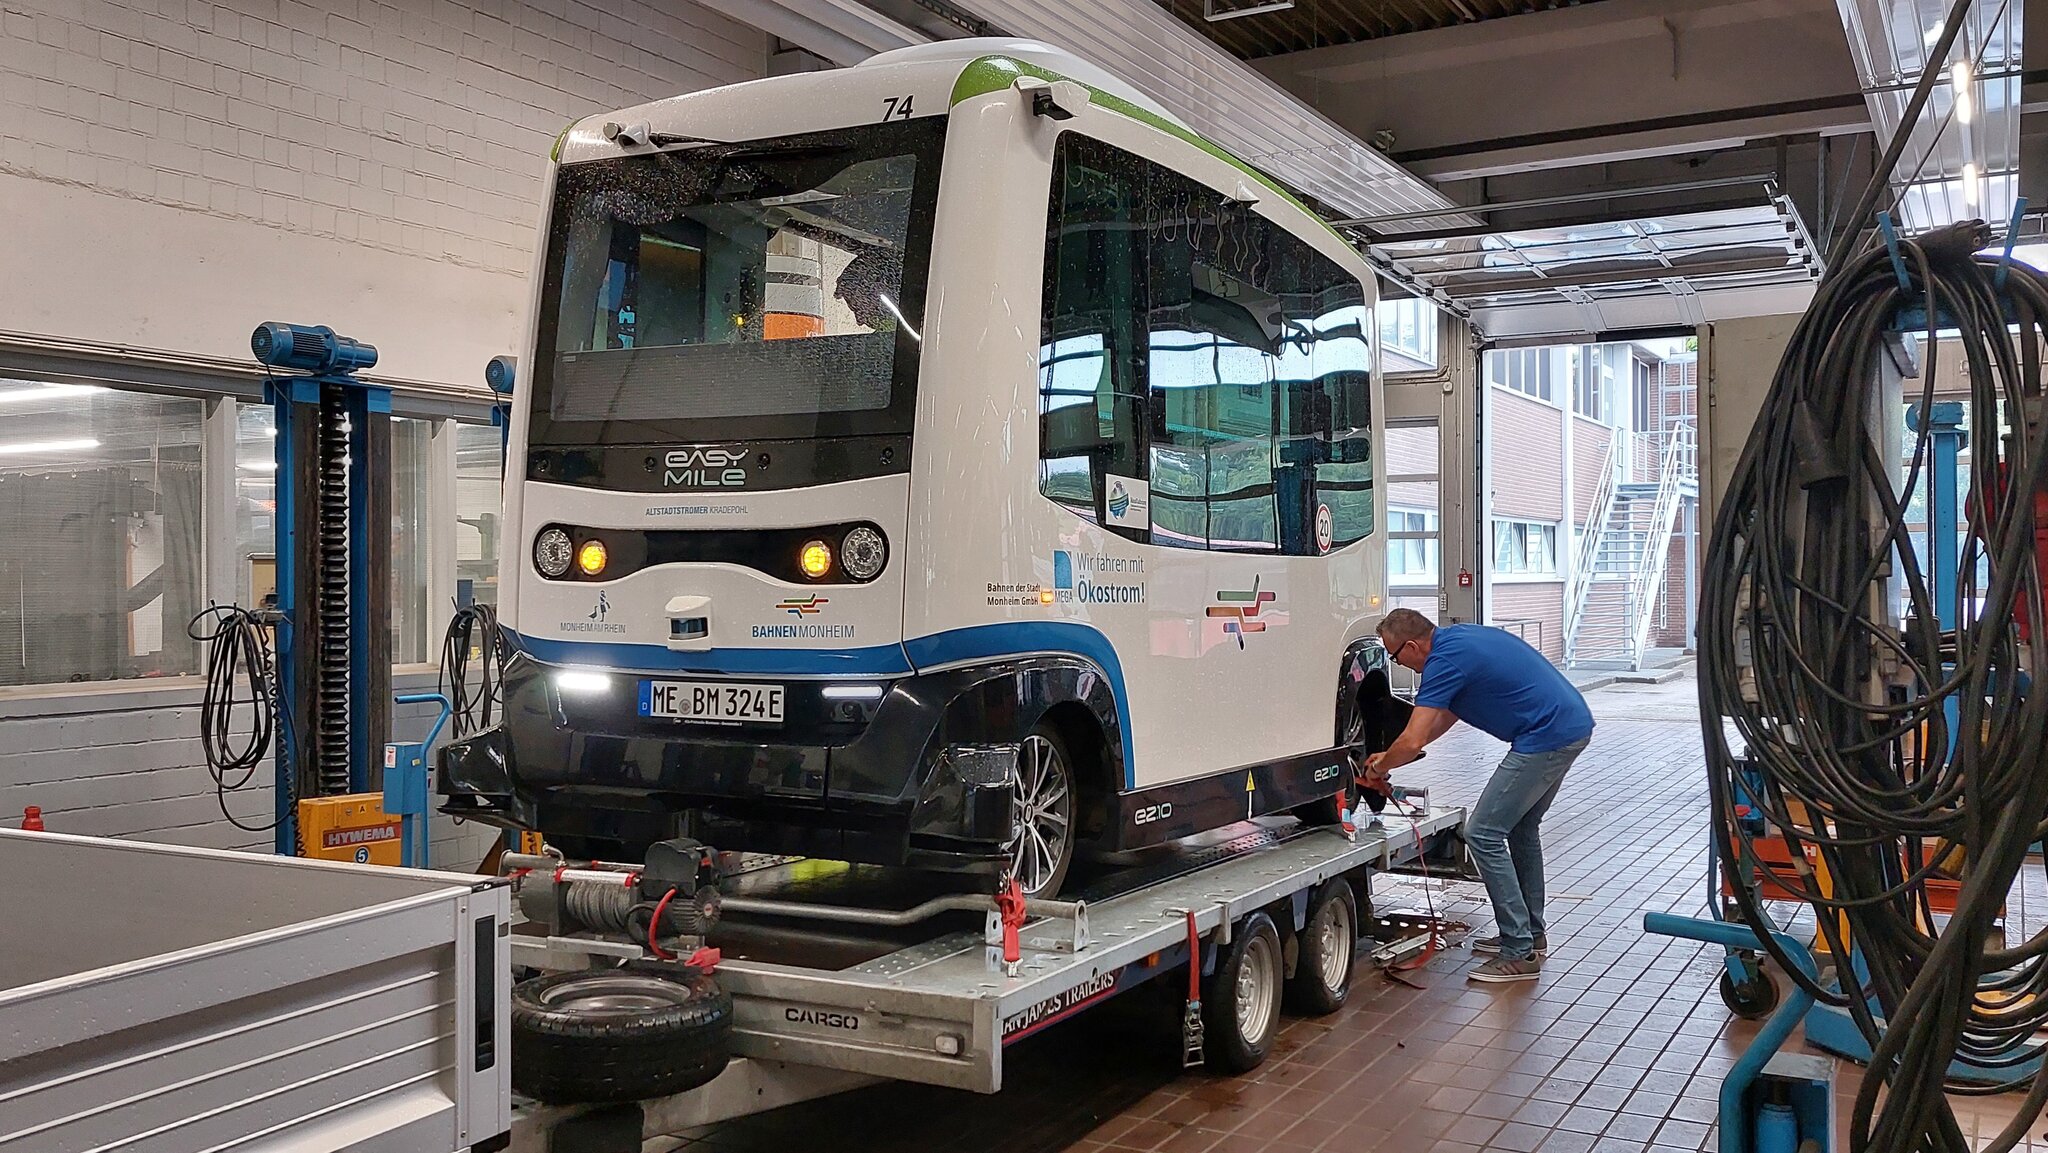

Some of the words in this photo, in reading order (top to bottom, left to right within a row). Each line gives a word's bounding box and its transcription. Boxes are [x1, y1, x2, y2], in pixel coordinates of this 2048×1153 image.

[883, 95, 914, 122] 74
[645, 506, 708, 516] ALTSTADTSTROMER
[709, 505, 748, 514] KRADEPOHL
[1320, 519, 1329, 537] 20
[1077, 552, 1094, 570] Wir
[1096, 553, 1127, 572] fahren
[1129, 555, 1145, 573] mit
[987, 582, 1014, 592] Bahnen
[1015, 582, 1026, 592] der
[1026, 583, 1041, 592] Stadt
[1078, 574, 1145, 603] Ökostrom!
[987, 596, 1020, 606] Monheim
[1021, 596, 1039, 605] GmbH
[1055, 591, 1073, 603] MEGA
[752, 625, 797, 638] BAHNEN
[798, 625, 854, 638] MONHEIM
[641, 702, 648, 711] D
[653, 686, 678, 714] ME
[693, 687, 719, 715] BM
[328, 826, 395, 845] HYWEMA
[357, 850, 366, 863] 5
[785, 1008, 859, 1030] CARGO
